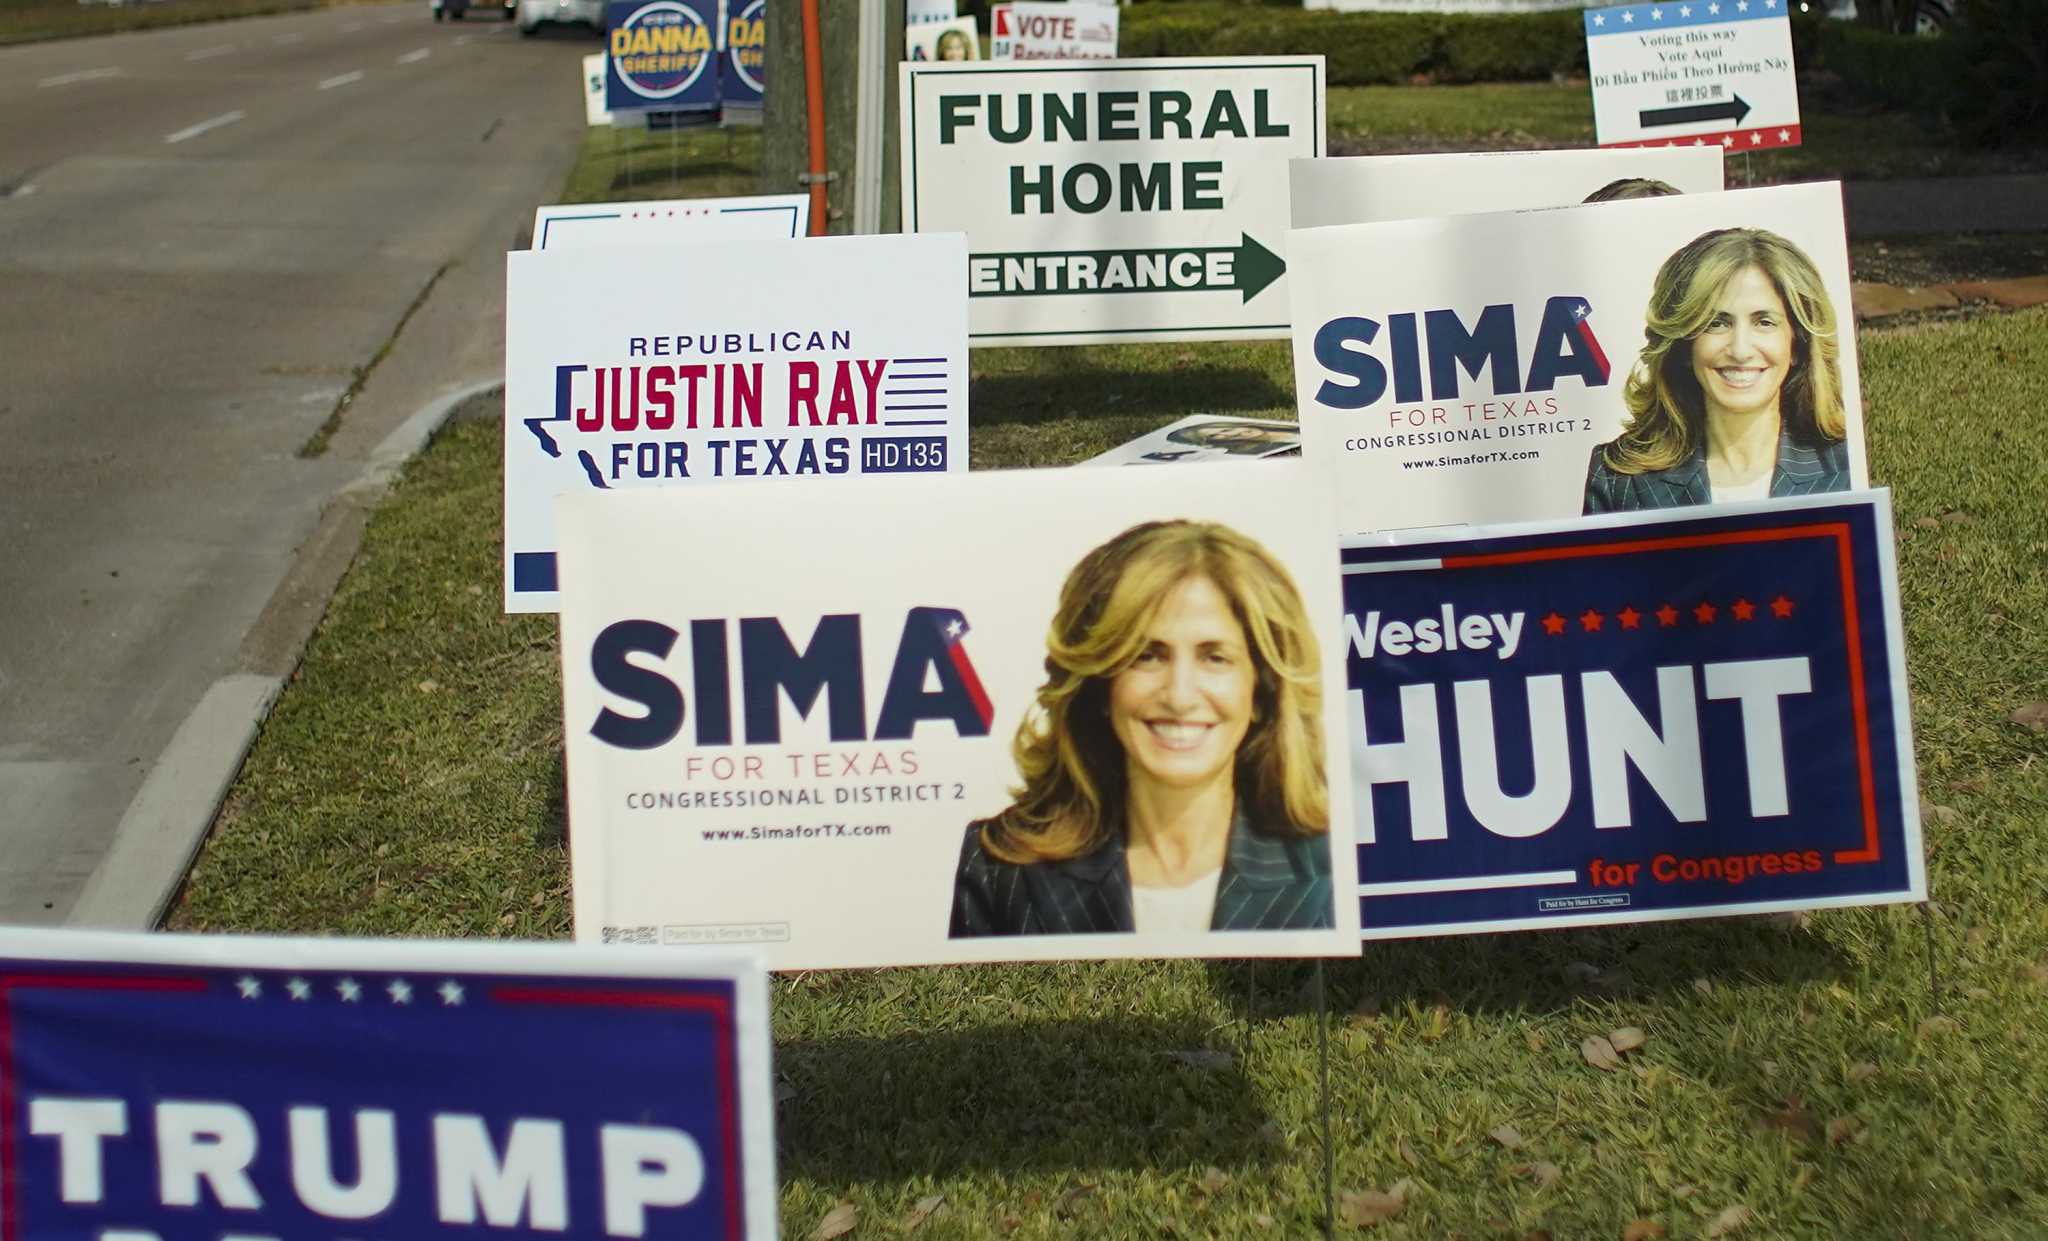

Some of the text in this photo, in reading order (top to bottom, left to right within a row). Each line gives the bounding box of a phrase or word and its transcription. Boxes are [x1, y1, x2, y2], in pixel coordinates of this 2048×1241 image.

[611, 24, 712, 56] DANNA
[1017, 16, 1075, 39] VOTE
[1639, 30, 1737, 47] Voting this way
[623, 53, 700, 73] SHERIFF
[1658, 51, 1688, 62] Vote
[1683, 66, 1713, 78] Theo
[939, 88, 1290, 145] FUNERAL
[1010, 160, 1224, 215] HOME
[970, 252, 1236, 293] ENTRANCE
[629, 330, 851, 356] REPUBLICAN
[1313, 296, 1611, 409] SIMA
[576, 359, 889, 432] JUSTIN RAY
[1390, 397, 1559, 428] FOR TEXAS
[1345, 419, 1592, 451] CONGRESSIONAL DISTRICT 2
[611, 437, 943, 479] FOR TEXAS HD135
[1403, 448, 1540, 471] www.SimaforTX.com
[1343, 604, 1526, 660] Wesley
[589, 606, 994, 751] SIMA
[686, 750, 920, 781] FOR TEXAS
[1346, 656, 1813, 844] HUNT
[626, 784, 965, 809] CONGRESSIONAL DISTRICT 2
[702, 823, 892, 842] www.SimaforTX.com
[1589, 847, 1822, 887] for Congress
[29, 1097, 706, 1239] TRUMP
